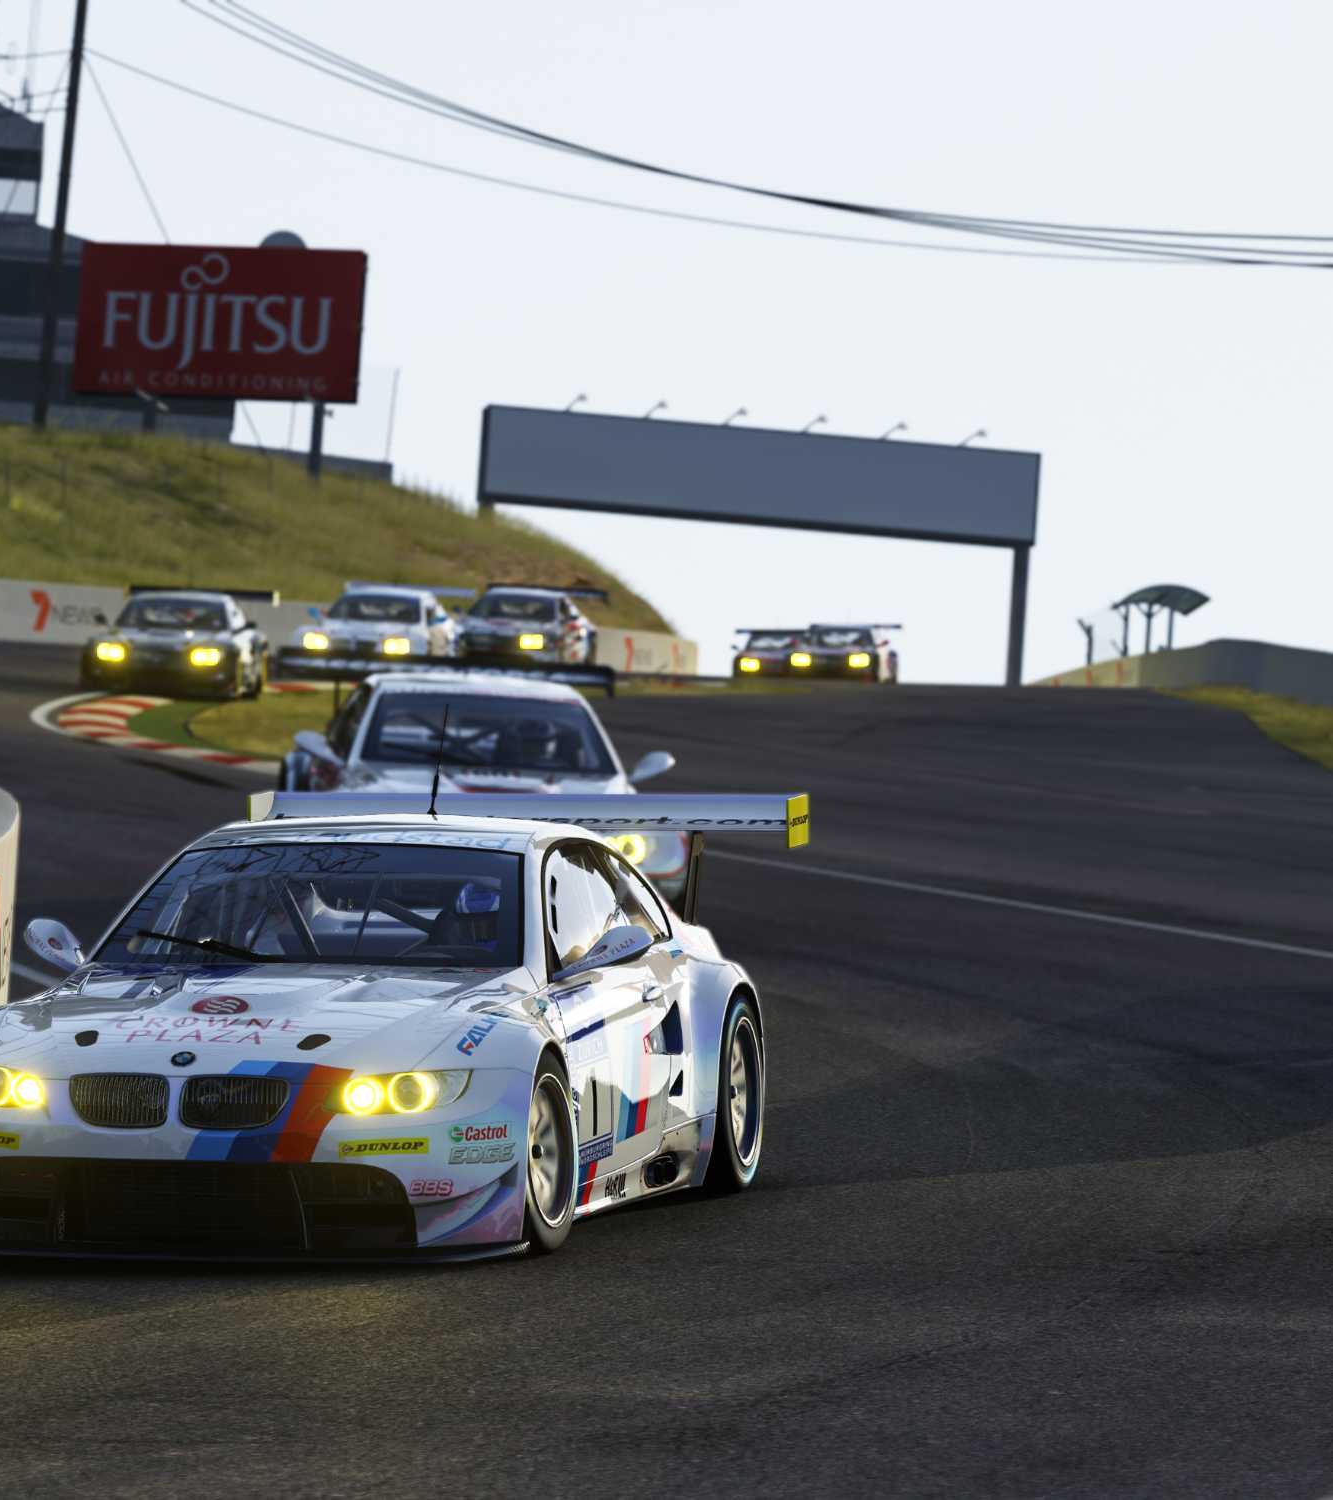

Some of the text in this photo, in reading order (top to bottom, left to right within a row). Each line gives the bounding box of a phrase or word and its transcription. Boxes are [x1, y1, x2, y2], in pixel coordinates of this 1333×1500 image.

[102, 290, 333, 369] FUJITSU
[98, 371, 328, 393] AIR CONDITIONING
[116, 1014, 306, 1033] CROWNE
[126, 1028, 262, 1045] PLAZA
[465, 1124, 508, 1141] Castrol
[355, 1141, 425, 1153] DUNLOP
[448, 1142, 516, 1165] EDGE
[409, 1178, 454, 1197] BBS
